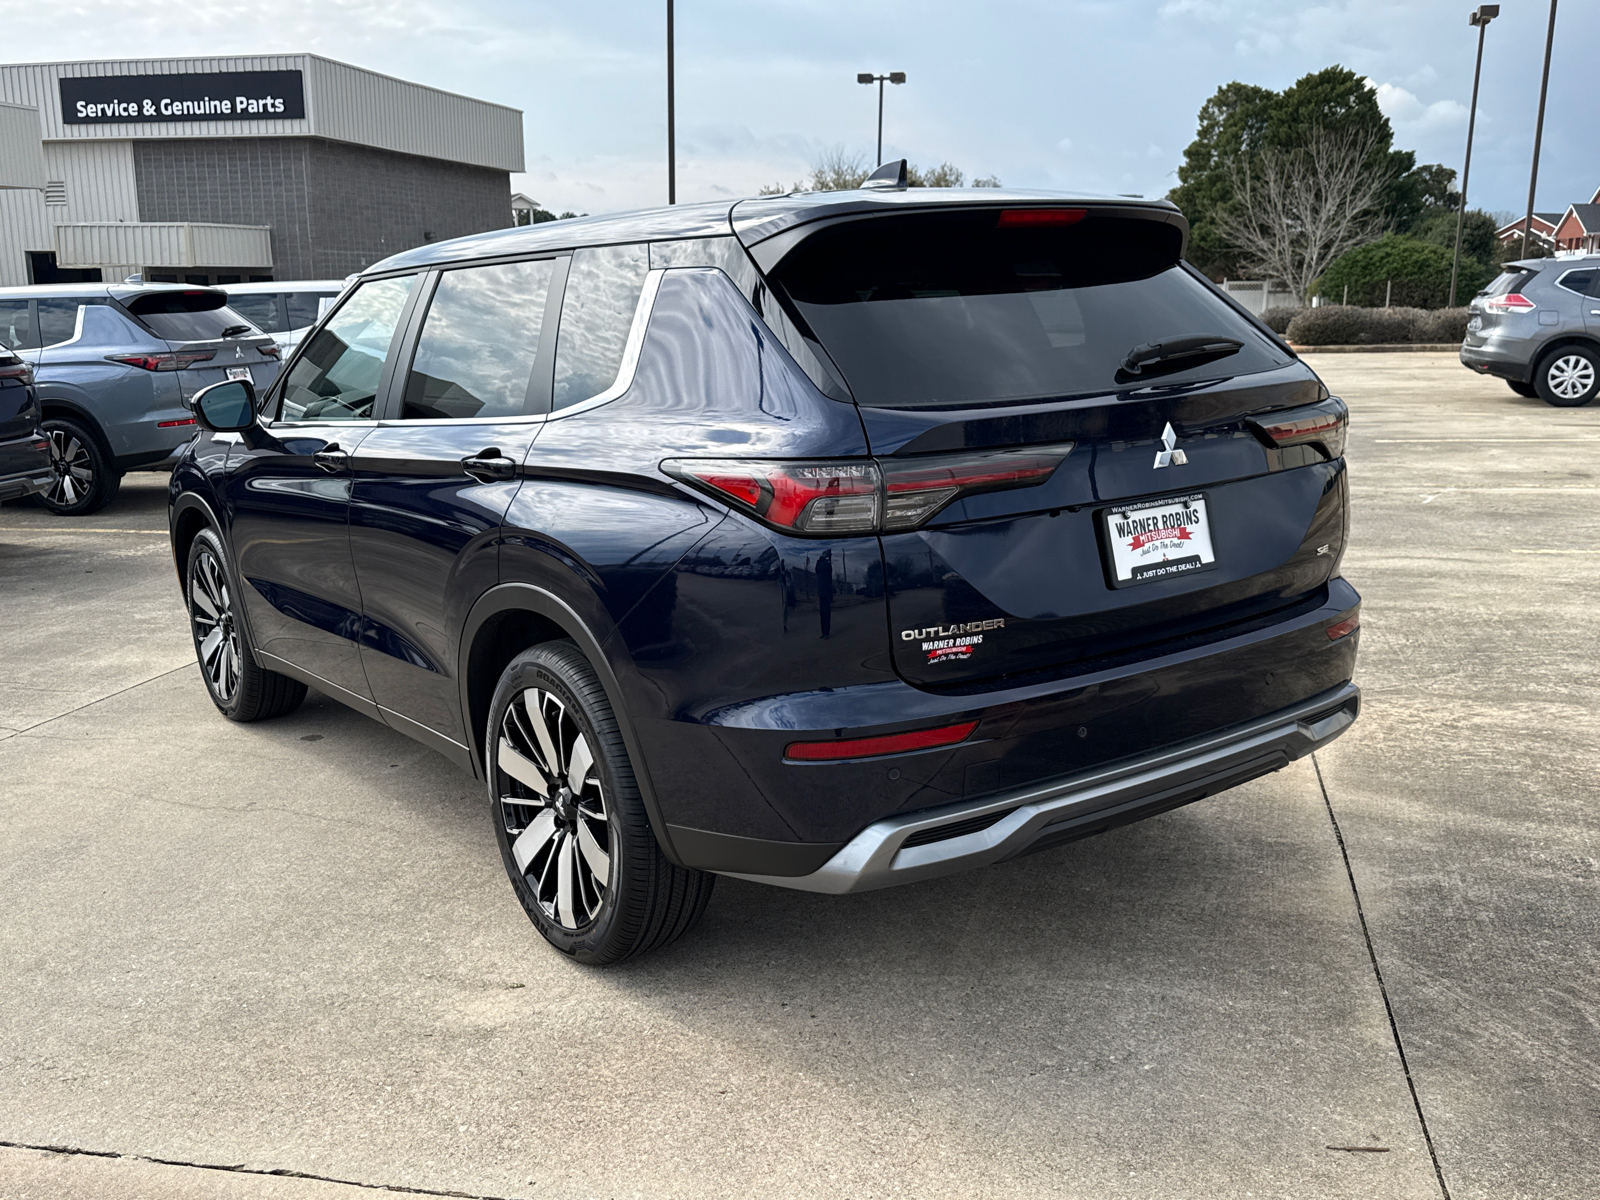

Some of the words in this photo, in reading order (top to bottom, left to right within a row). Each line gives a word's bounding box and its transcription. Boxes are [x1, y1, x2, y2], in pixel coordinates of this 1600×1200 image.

[76, 99, 139, 117] Service
[142, 98, 157, 116] &
[160, 96, 232, 115] Genuine
[235, 95, 285, 113] Parts
[1115, 515, 1160, 538] WARNER
[1161, 508, 1200, 529] ROBINS
[1139, 528, 1181, 544] MITSUBISHI
[1140, 546, 1151, 557] Just
[1152, 543, 1159, 551] Do
[1160, 541, 1169, 550] The
[1142, 569, 1157, 579] JUST
[1157, 567, 1166, 576] DO
[1166, 564, 1178, 574] THE
[1178, 561, 1196, 572] DEAL!
[901, 618, 1006, 641] OUTLANDER
[921, 639, 954, 651] WARNER
[955, 634, 984, 646] ROBINS
